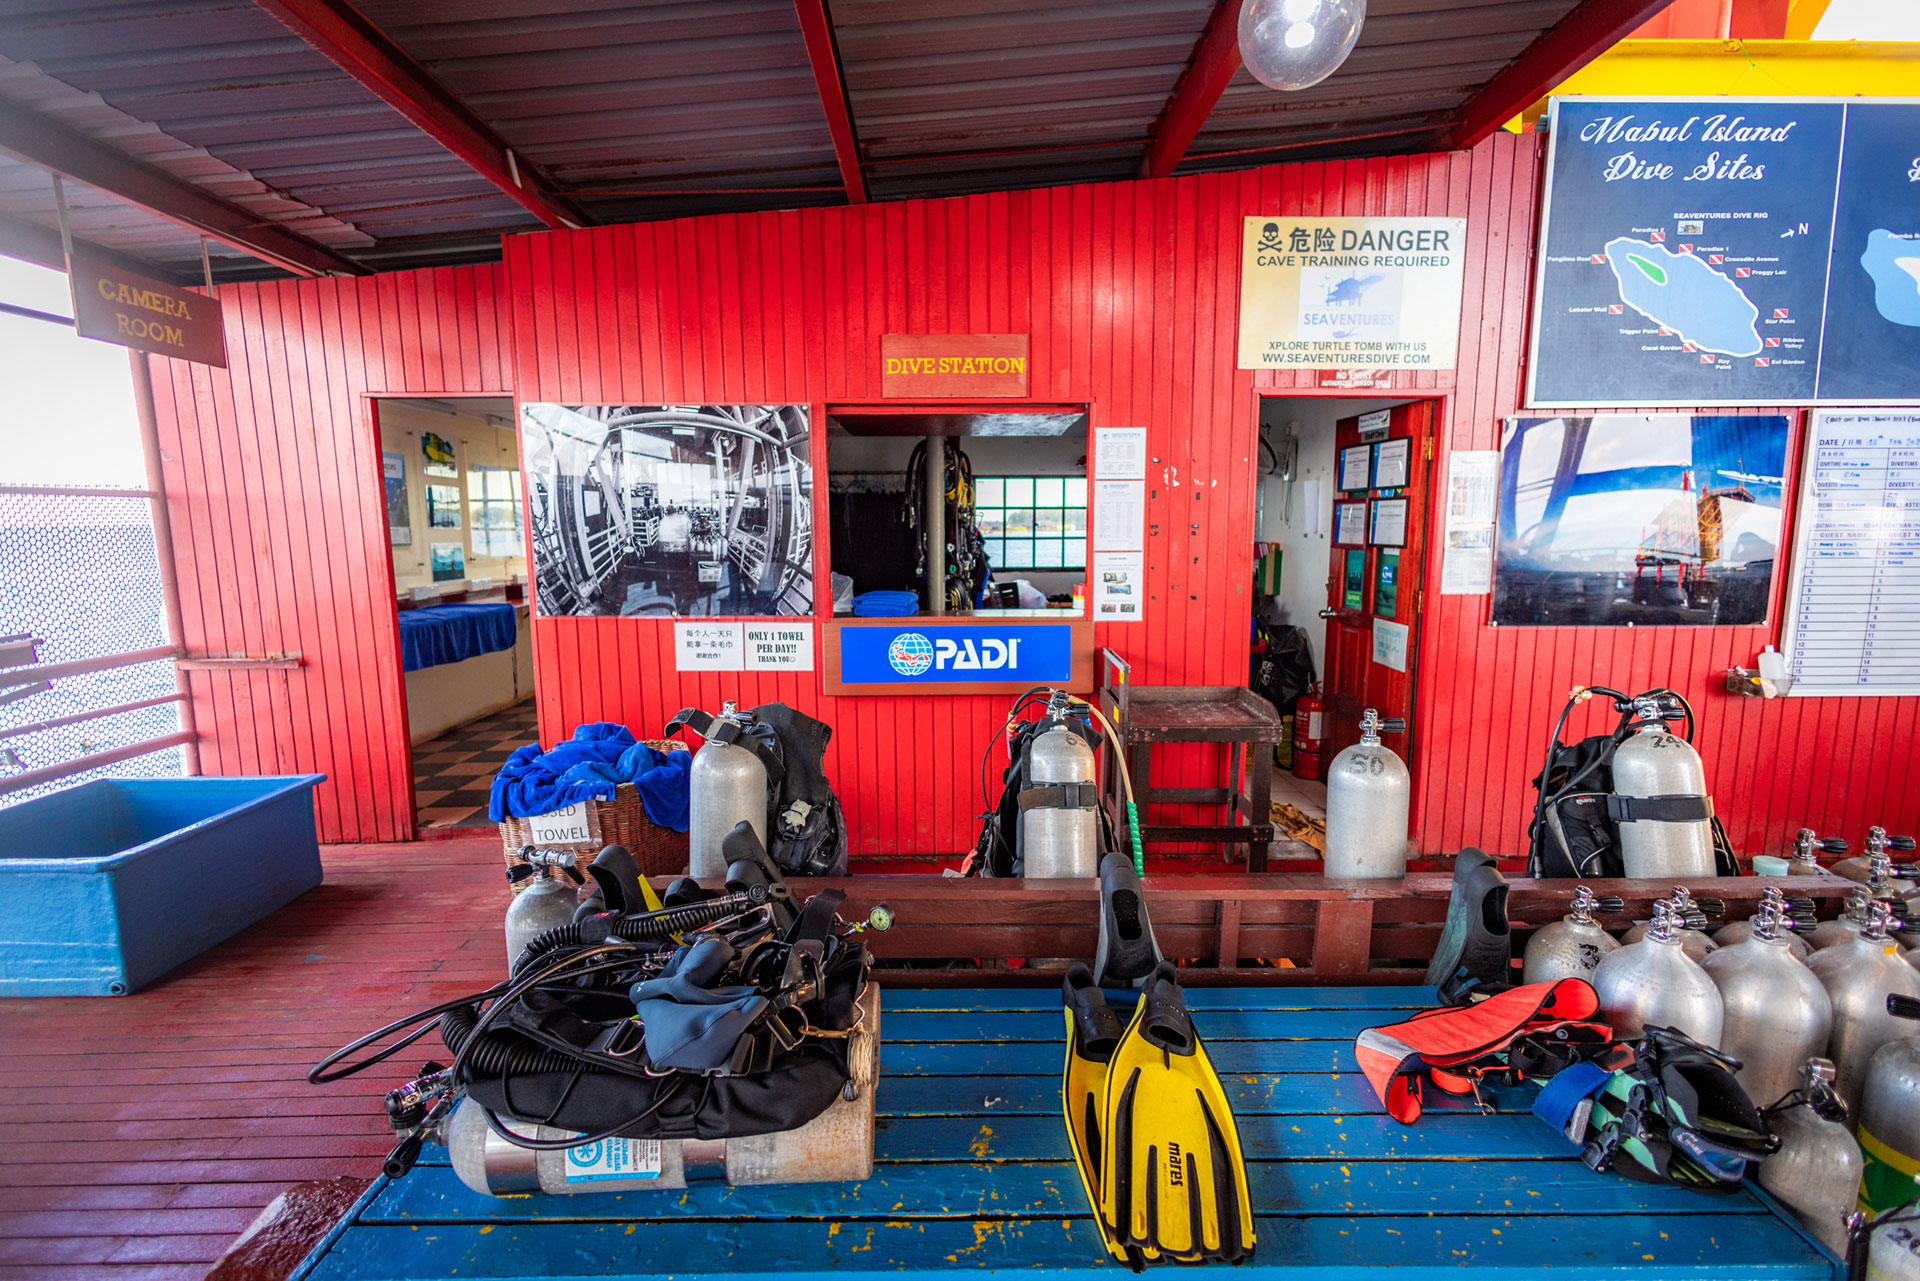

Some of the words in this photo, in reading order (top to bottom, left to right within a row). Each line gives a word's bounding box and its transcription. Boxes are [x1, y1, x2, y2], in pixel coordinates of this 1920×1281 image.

[1580, 115, 1700, 144] Mabul
[1701, 114, 1797, 142] Island
[1604, 152, 1673, 182] Dive
[1684, 152, 1765, 181] Sites
[1798, 223, 1809, 235] N
[1289, 227, 1336, 252] 危险
[1342, 230, 1449, 251] DANGER
[1257, 256, 1295, 267] CAVE
[1301, 256, 1369, 267] TRAINING
[1374, 256, 1449, 267] REQUIRED
[98, 279, 192, 320] CAMERA
[1304, 313, 1394, 325] SEAVENTURES
[115, 313, 184, 347] ROOM
[1269, 341, 1309, 350] XPLORE
[1313, 341, 1350, 350] TURTLE
[1354, 341, 1382, 351] TOMB
[1386, 342, 1410, 351] WITH
[1413, 342, 1427, 351] US
[886, 358, 936, 375] DIVE
[939, 357, 1025, 374] STATION
[1336, 371, 1347, 380] NO
[686, 629, 733, 638] 每个人一天只
[748, 632, 769, 641] ONLY
[771, 632, 775, 641] 1
[778, 632, 805, 641] TOWEL
[757, 644, 773, 653] PER
[775, 644, 797, 653] DAY!!
[936, 639, 1018, 669] PADI
[535, 827, 588, 842] TOWEL
[1168, 1142, 1183, 1187] mares
